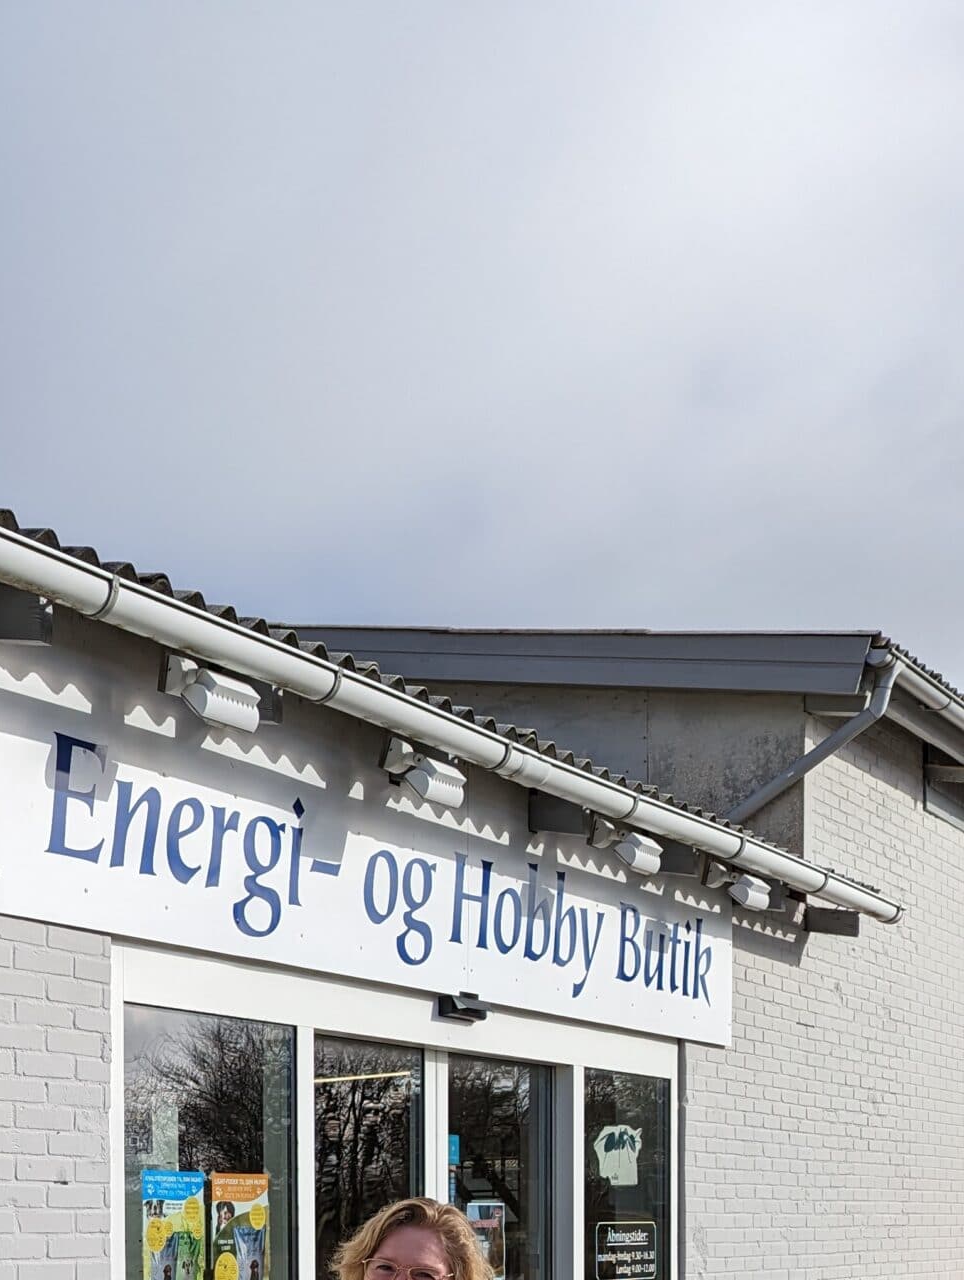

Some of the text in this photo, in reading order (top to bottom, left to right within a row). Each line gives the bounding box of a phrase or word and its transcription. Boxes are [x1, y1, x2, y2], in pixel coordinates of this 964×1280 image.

[45, 731, 713, 1007] Energi- og Hobby Butik
[607, 1227, 649, 1243] Åbningstider:
